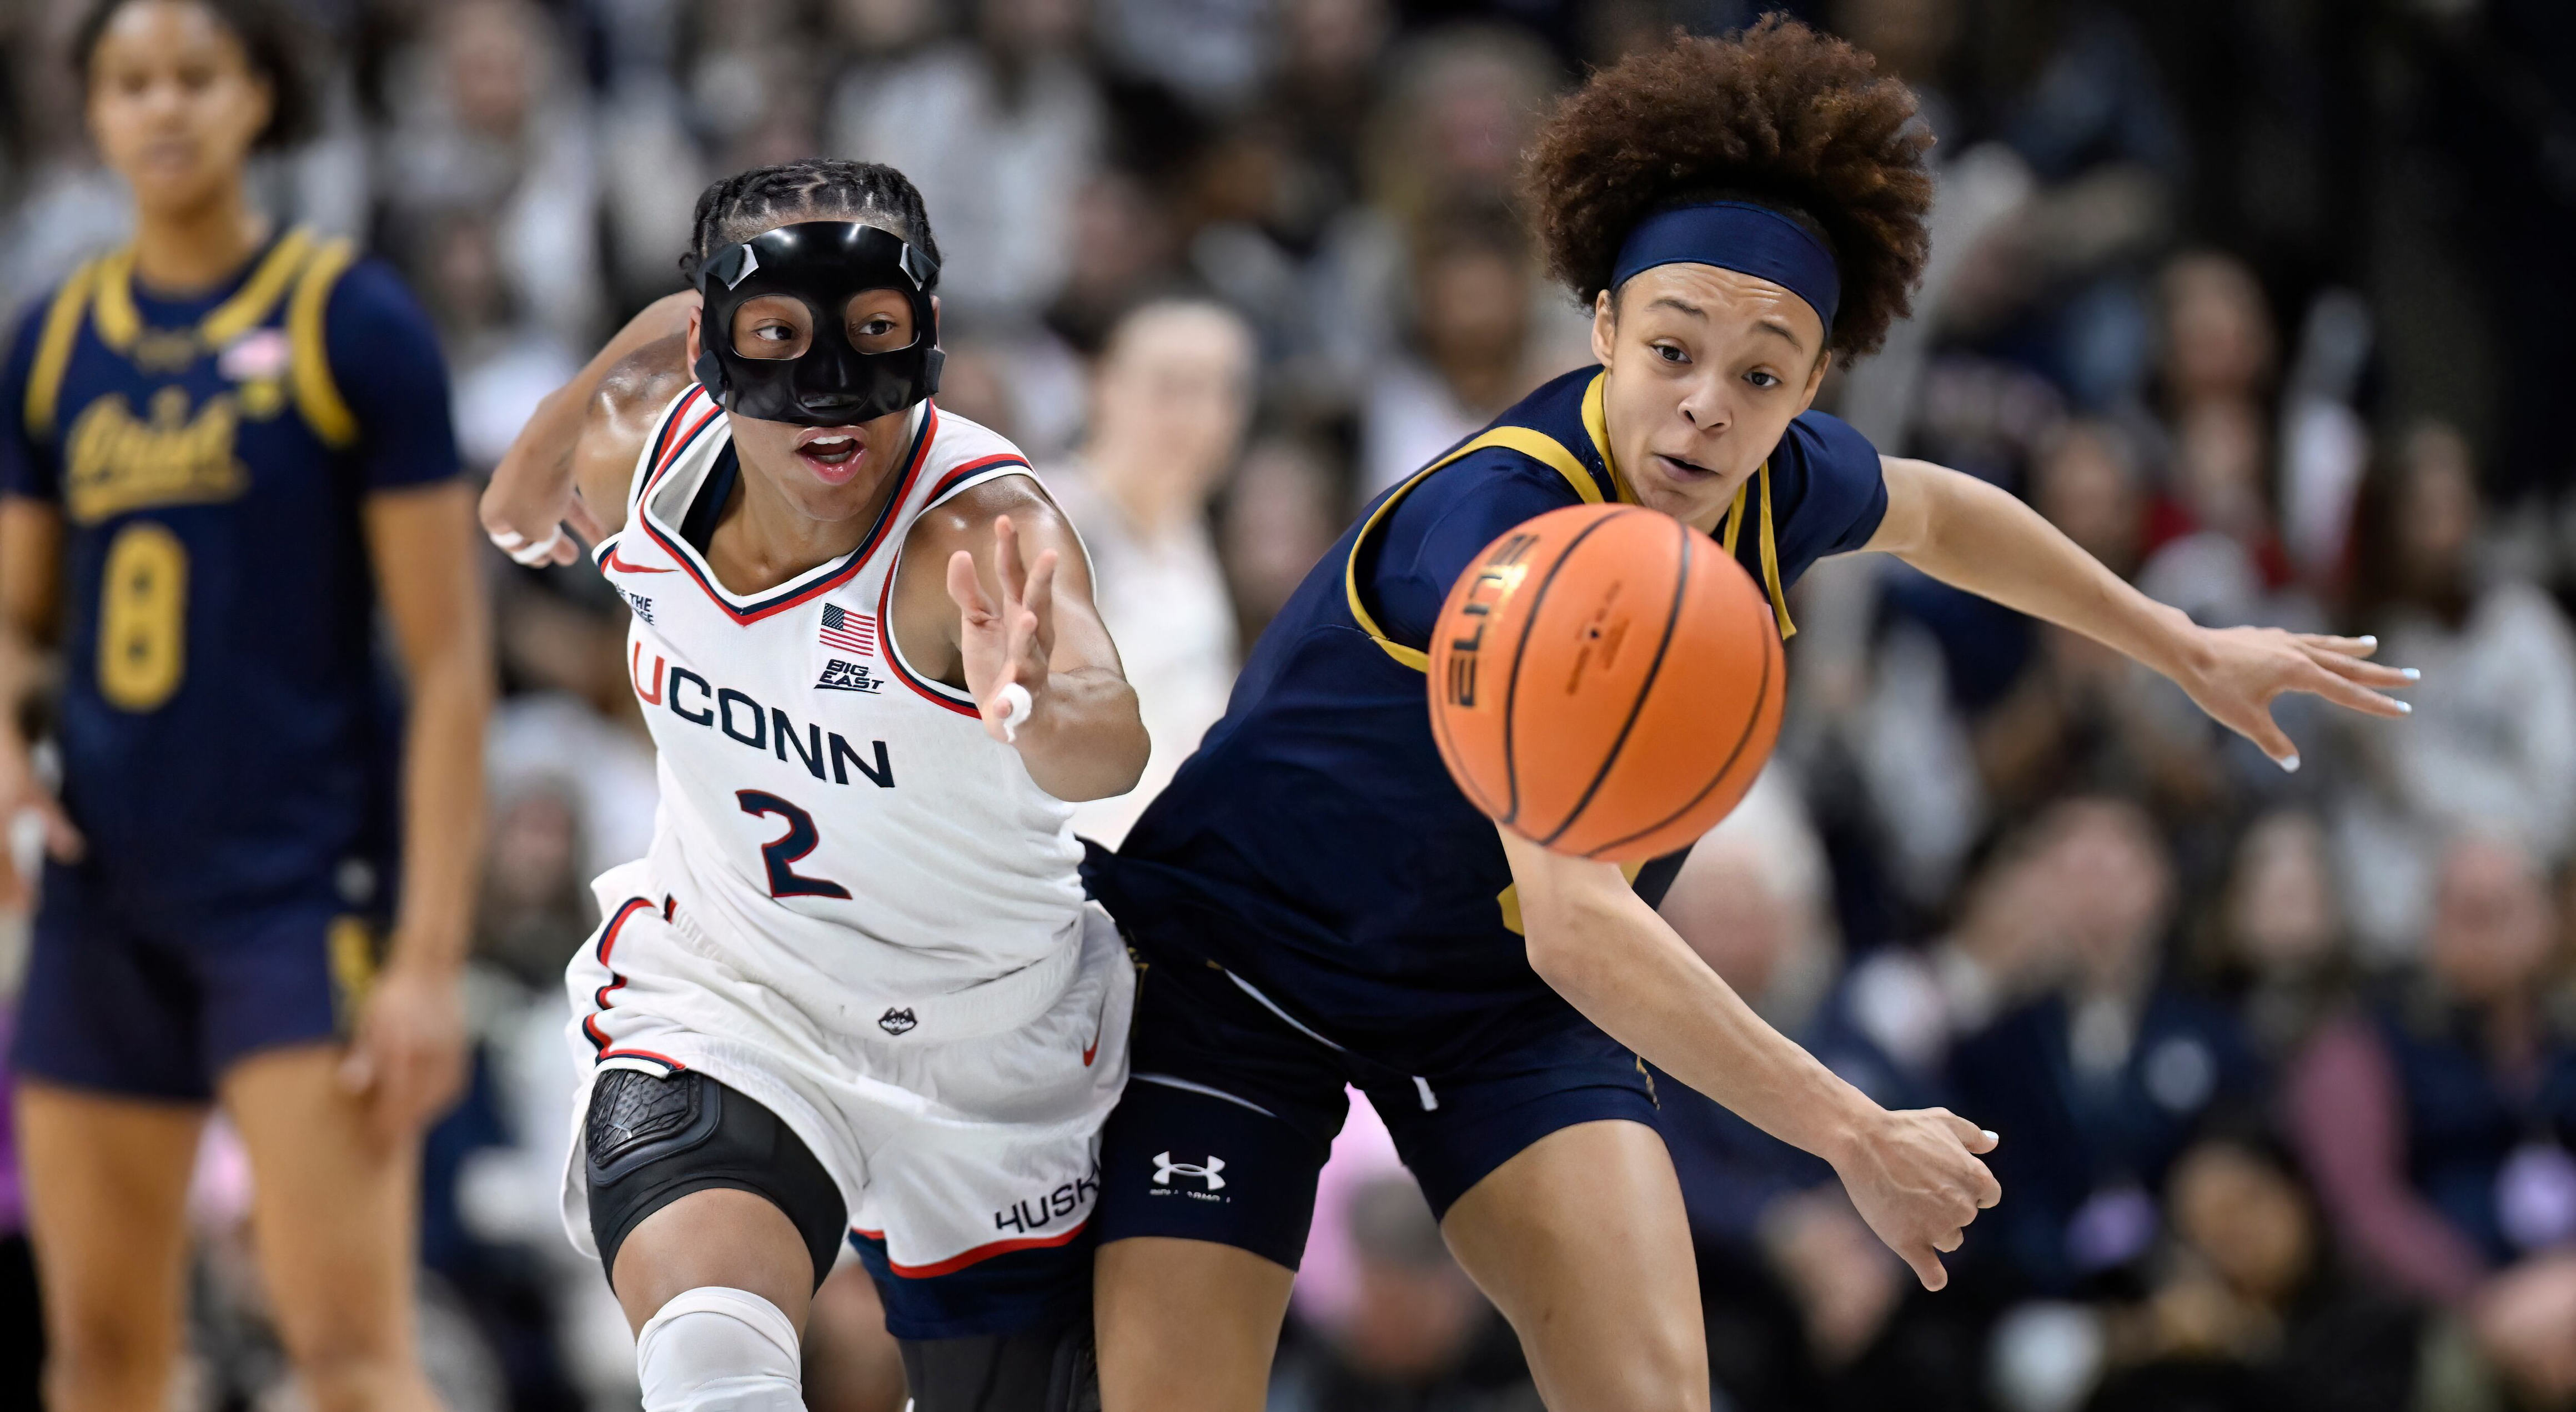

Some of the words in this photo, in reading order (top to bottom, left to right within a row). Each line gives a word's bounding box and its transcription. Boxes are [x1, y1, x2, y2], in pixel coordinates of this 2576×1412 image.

[99, 523, 187, 711] 8
[629, 592, 652, 612] THE
[819, 670, 885, 690] EAST
[826, 659, 869, 676] BIG
[633, 641, 895, 788] UCONN
[735, 789, 852, 900] 2
